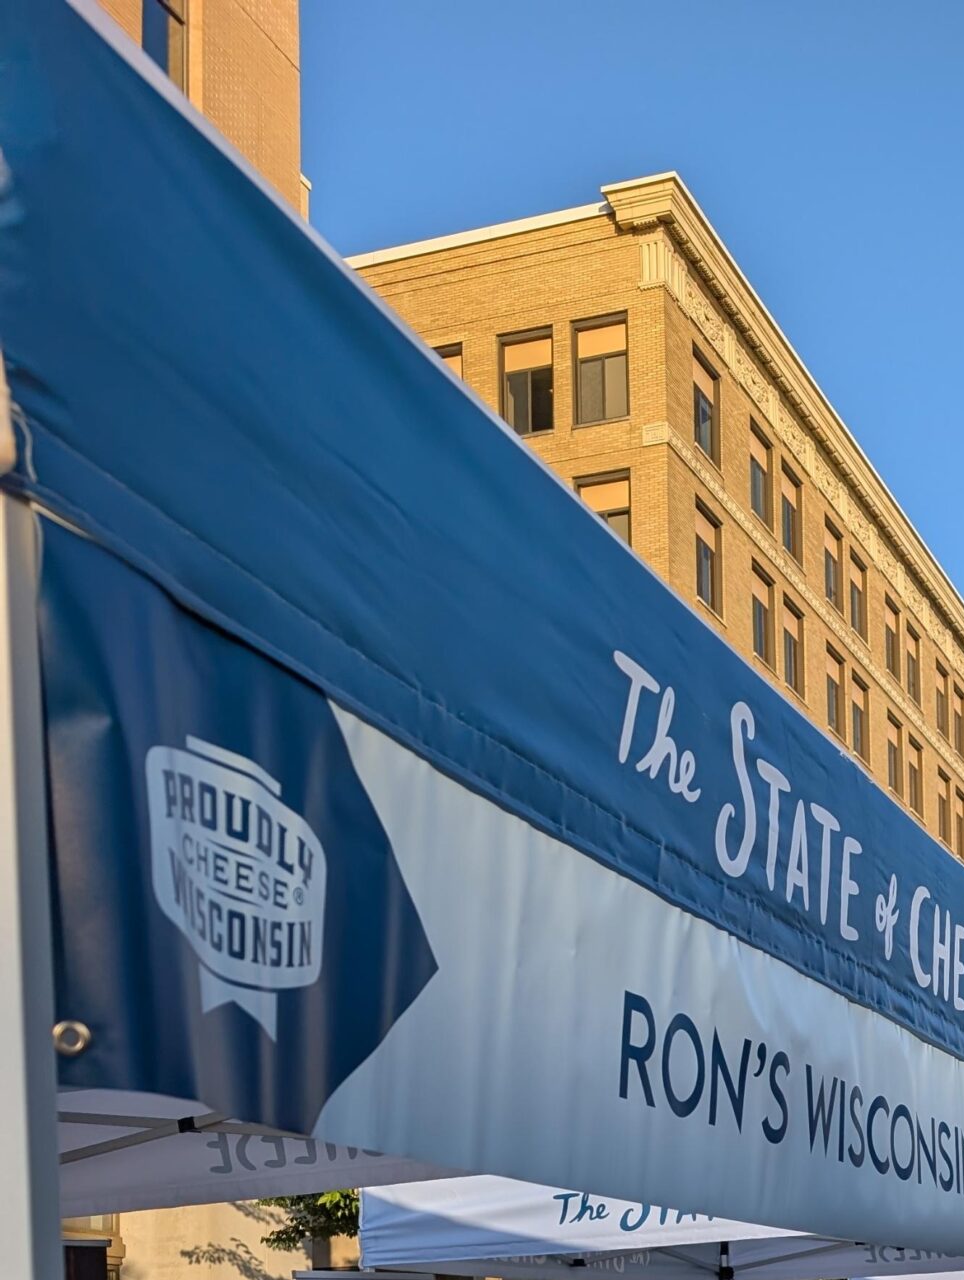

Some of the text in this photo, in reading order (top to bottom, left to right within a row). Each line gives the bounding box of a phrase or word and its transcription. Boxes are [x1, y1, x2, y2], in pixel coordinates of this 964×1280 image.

[163, 768, 314, 890] PROUDLY
[613, 650, 700, 803] The
[715, 701, 863, 941] STATE
[875, 872, 899, 961] of
[168, 849, 312, 968] WISCONSIN
[619, 990, 790, 1144] RON'S
[553, 1192, 610, 1225] The
